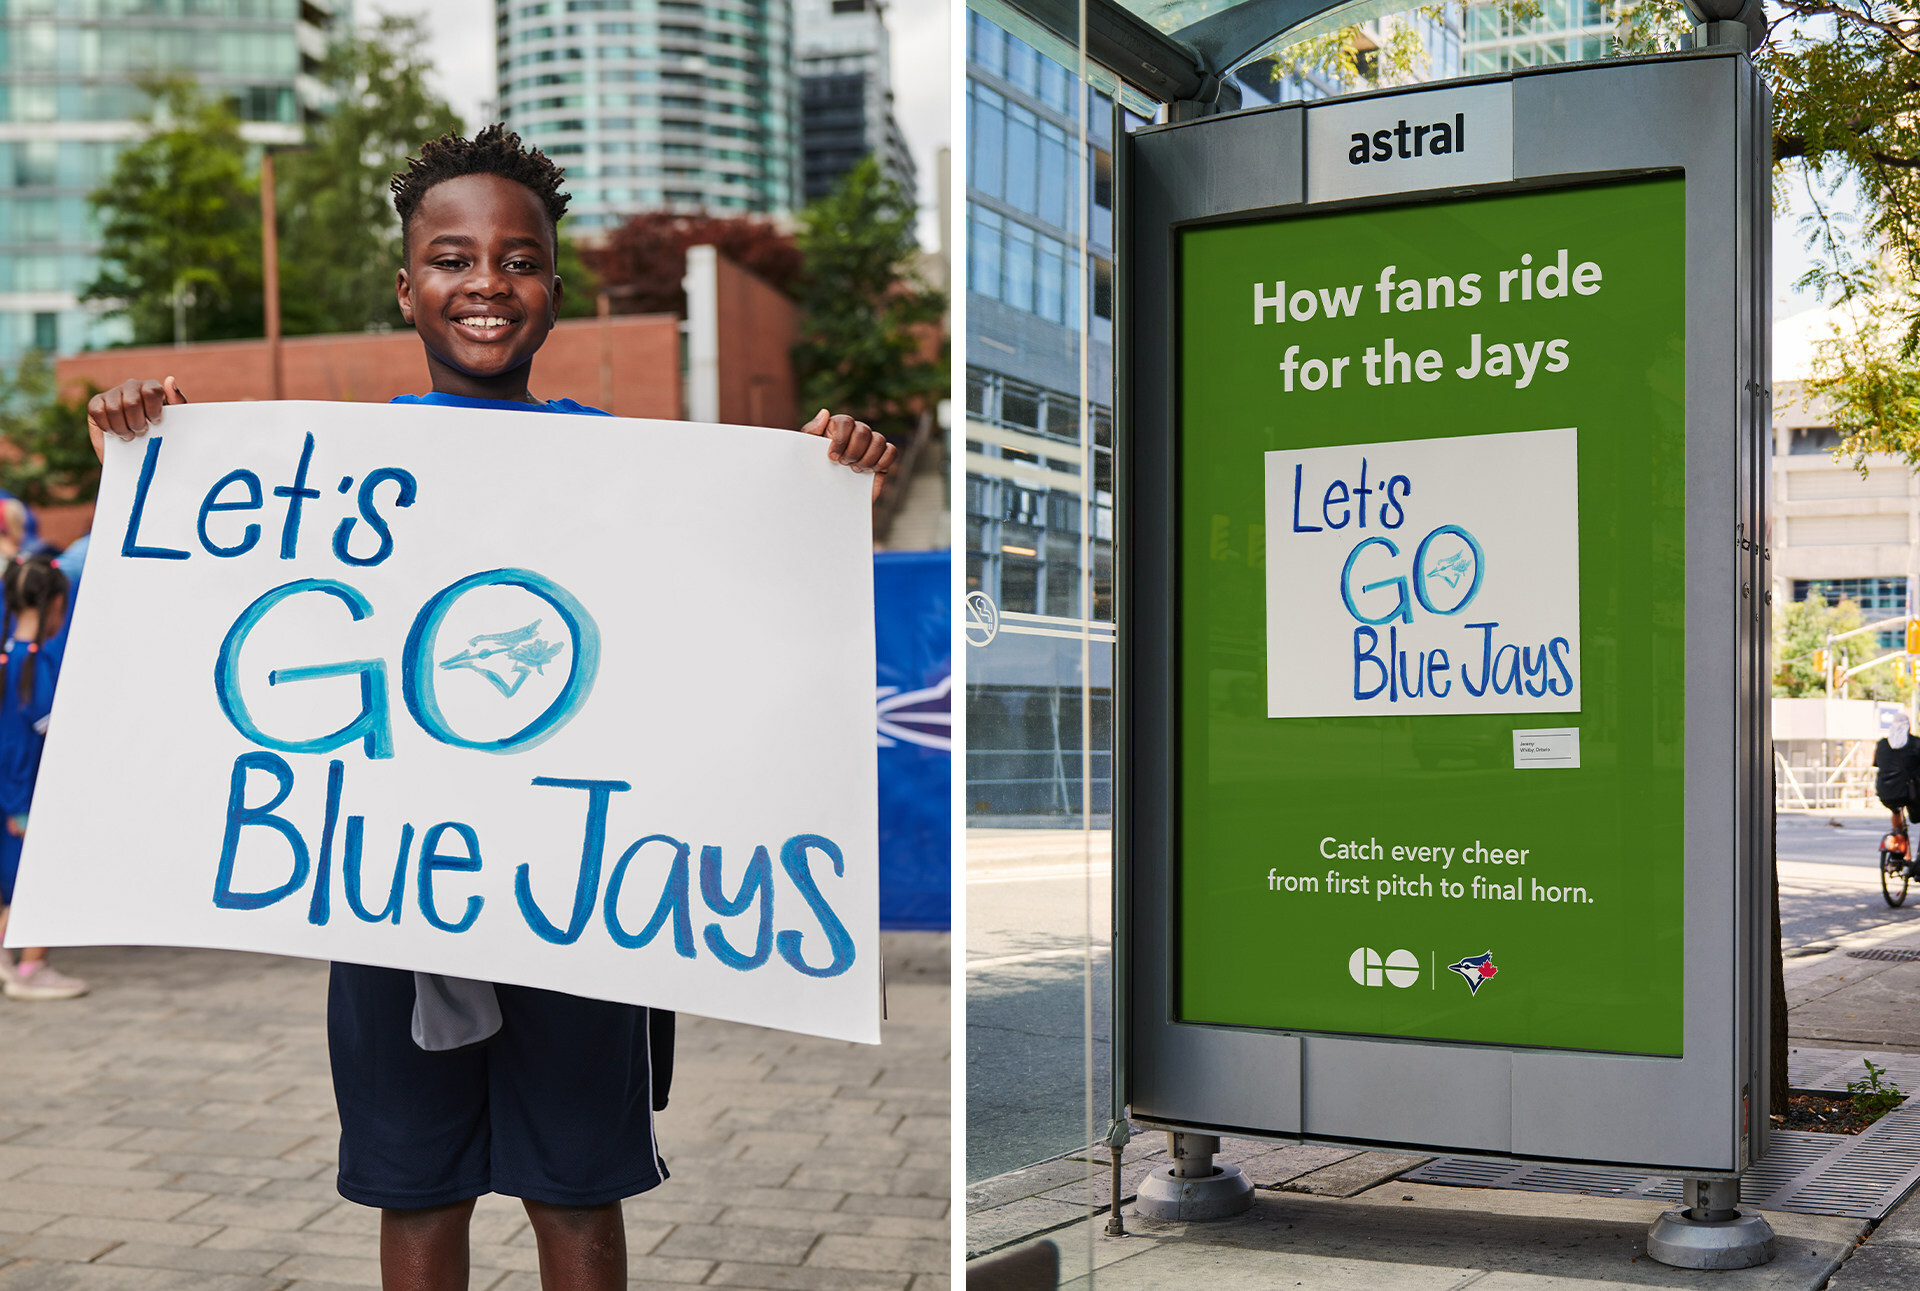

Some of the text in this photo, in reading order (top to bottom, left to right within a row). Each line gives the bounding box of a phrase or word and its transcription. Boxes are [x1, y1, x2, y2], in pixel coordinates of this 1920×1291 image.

[1349, 112, 1464, 165] astral
[1253, 248, 1603, 325] How fans ride
[1279, 333, 1570, 392] for the Jays
[121, 431, 418, 568] Let's
[1292, 457, 1412, 534] Let's
[1340, 524, 1485, 626] GO
[214, 567, 601, 760] GO
[1353, 622, 1574, 703] Blue Jays
[212, 751, 857, 979] Blue Jays
[1267, 868, 1594, 904] from first pitch to final horn.
[1319, 836, 1530, 870] Catch every cheer
